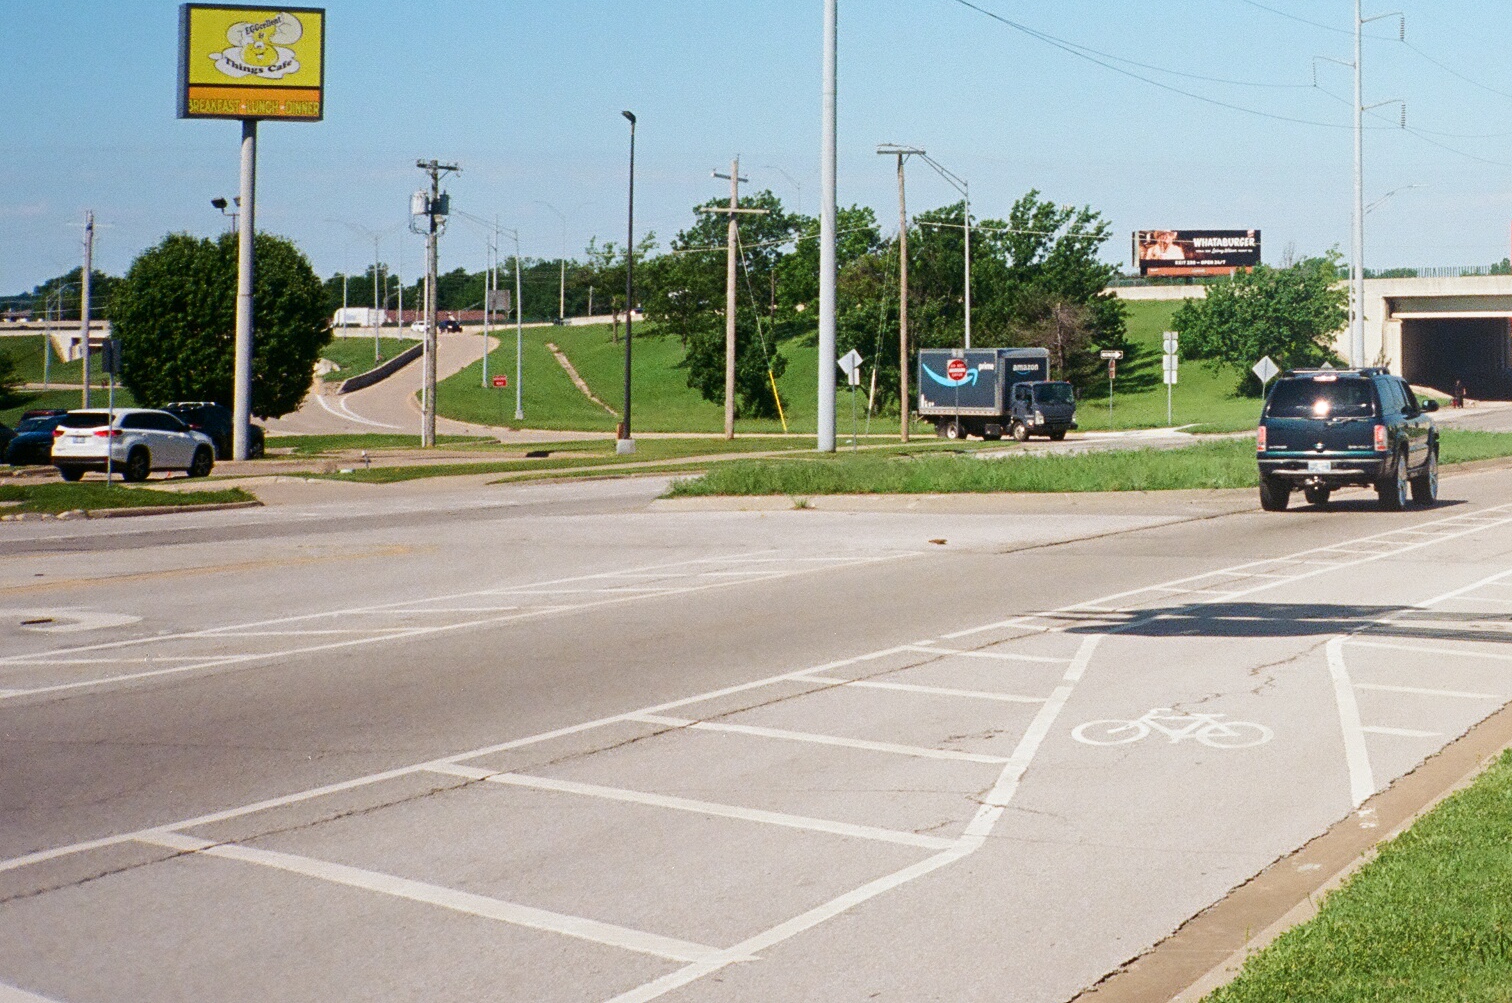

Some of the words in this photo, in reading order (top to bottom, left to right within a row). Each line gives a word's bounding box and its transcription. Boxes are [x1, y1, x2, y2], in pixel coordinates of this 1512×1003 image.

[224, 56, 264, 74] Things
[189, 99, 240, 113] BREAKFAST
[246, 101, 279, 114] LUNCH
[285, 102, 319, 115] DINNER
[1193, 237, 1255, 247] WHATABURGER
[978, 362, 994, 371] prime
